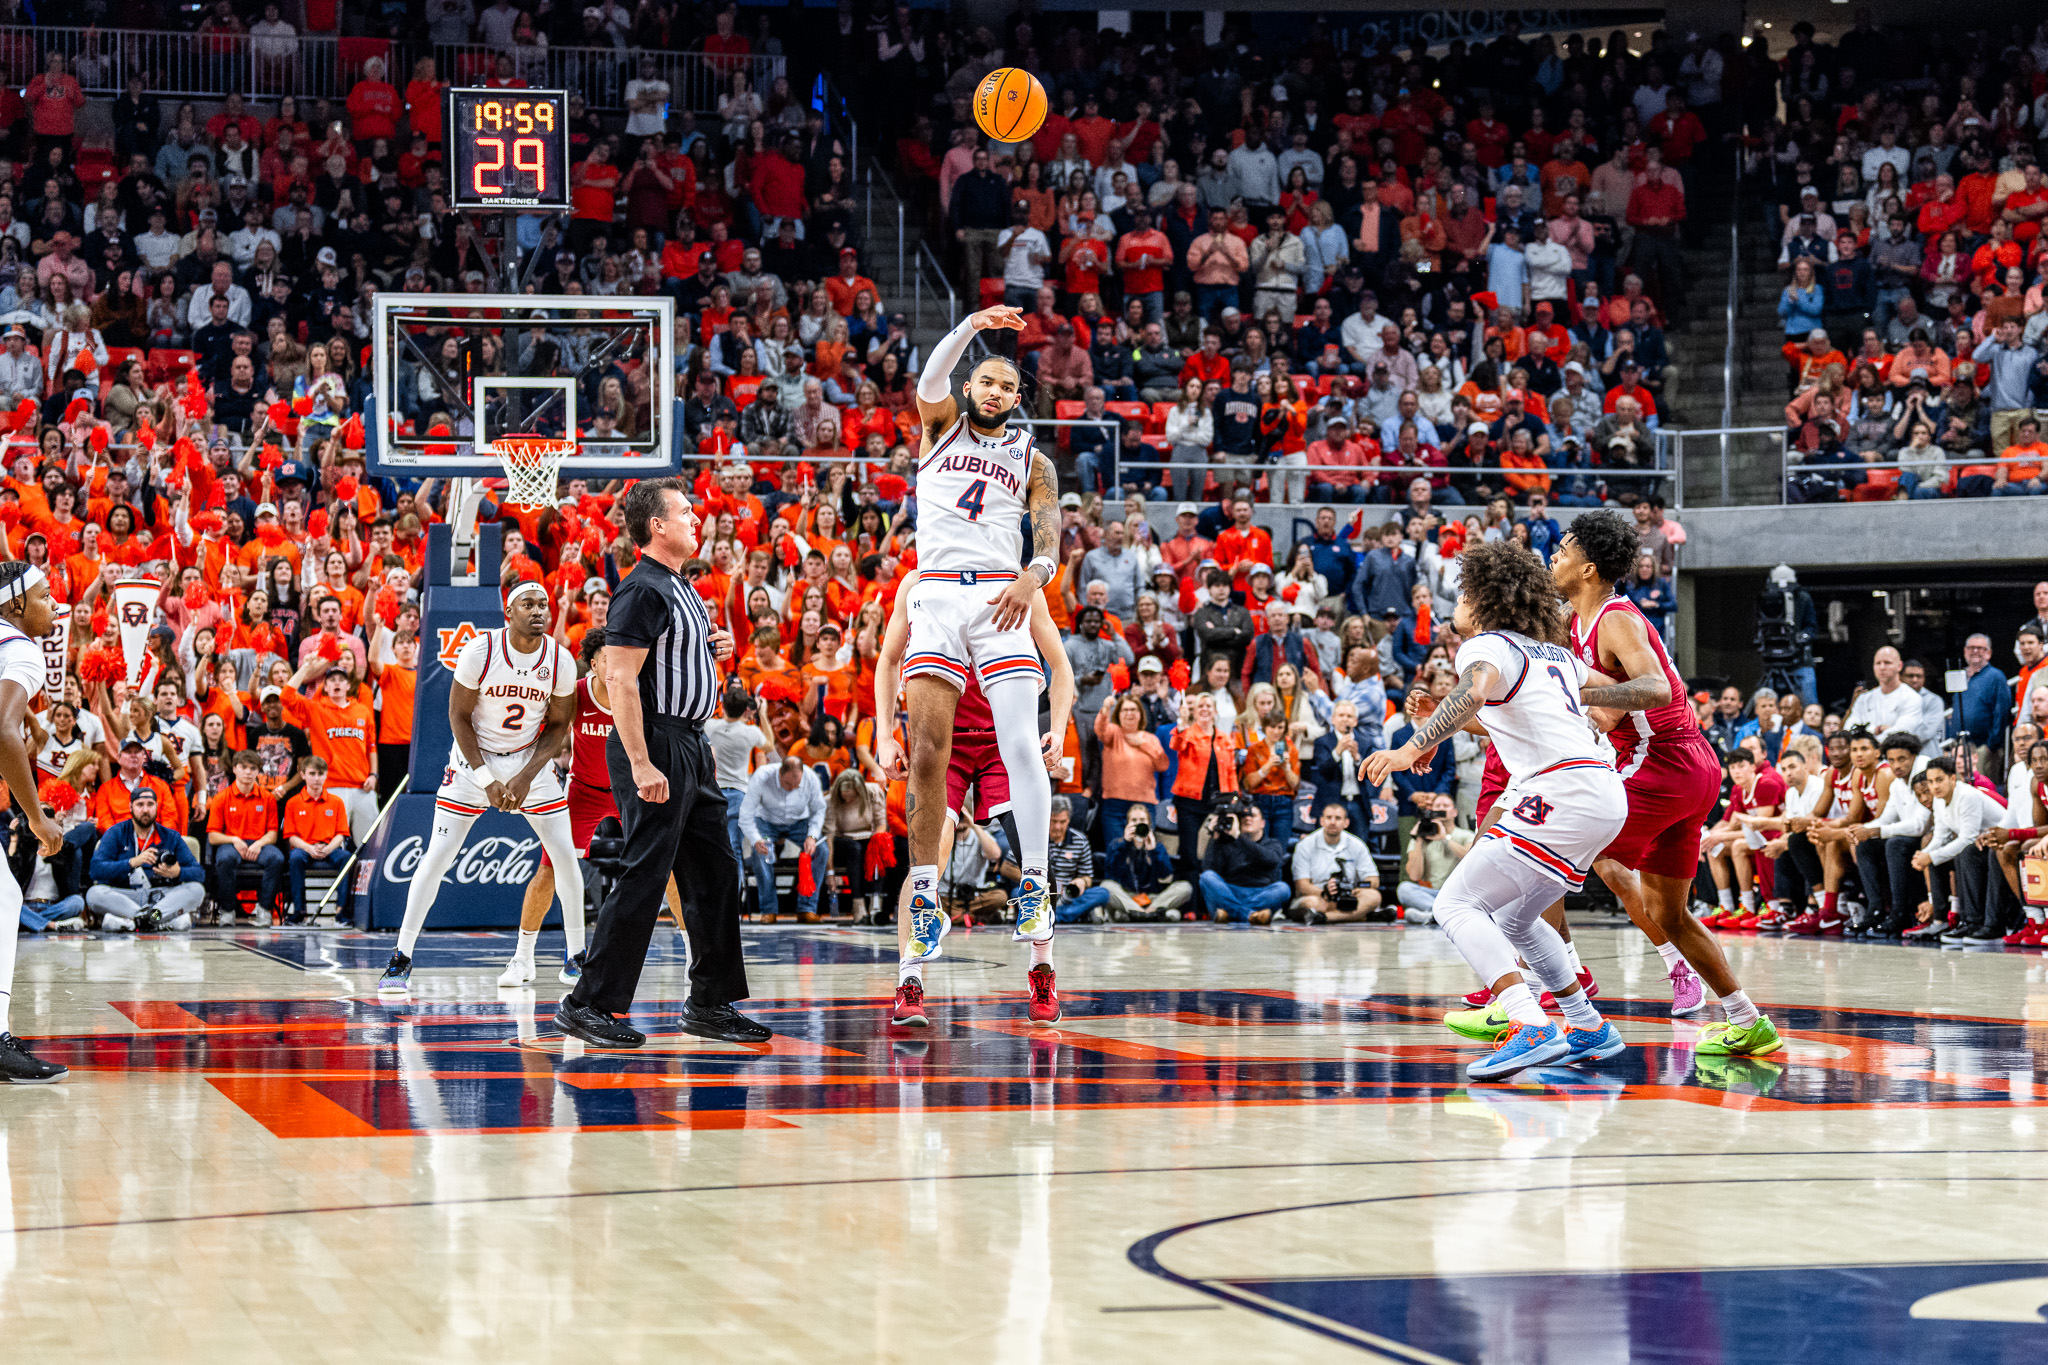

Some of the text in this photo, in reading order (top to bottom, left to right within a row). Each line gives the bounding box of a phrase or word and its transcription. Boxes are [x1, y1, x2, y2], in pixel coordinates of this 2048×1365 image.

[981, 71, 1004, 116] Wilson
[475, 101, 554, 134] 19:59
[473, 137, 545, 194] 29
[481, 197, 540, 205] DAKTRONICS
[937, 455, 1020, 496] AUBURN
[956, 478, 988, 521] 4
[485, 684, 551, 702] AUBURN
[1546, 665, 1583, 717] 3
[502, 704, 525, 730] 2
[1412, 691, 1473, 749] Donaldson
